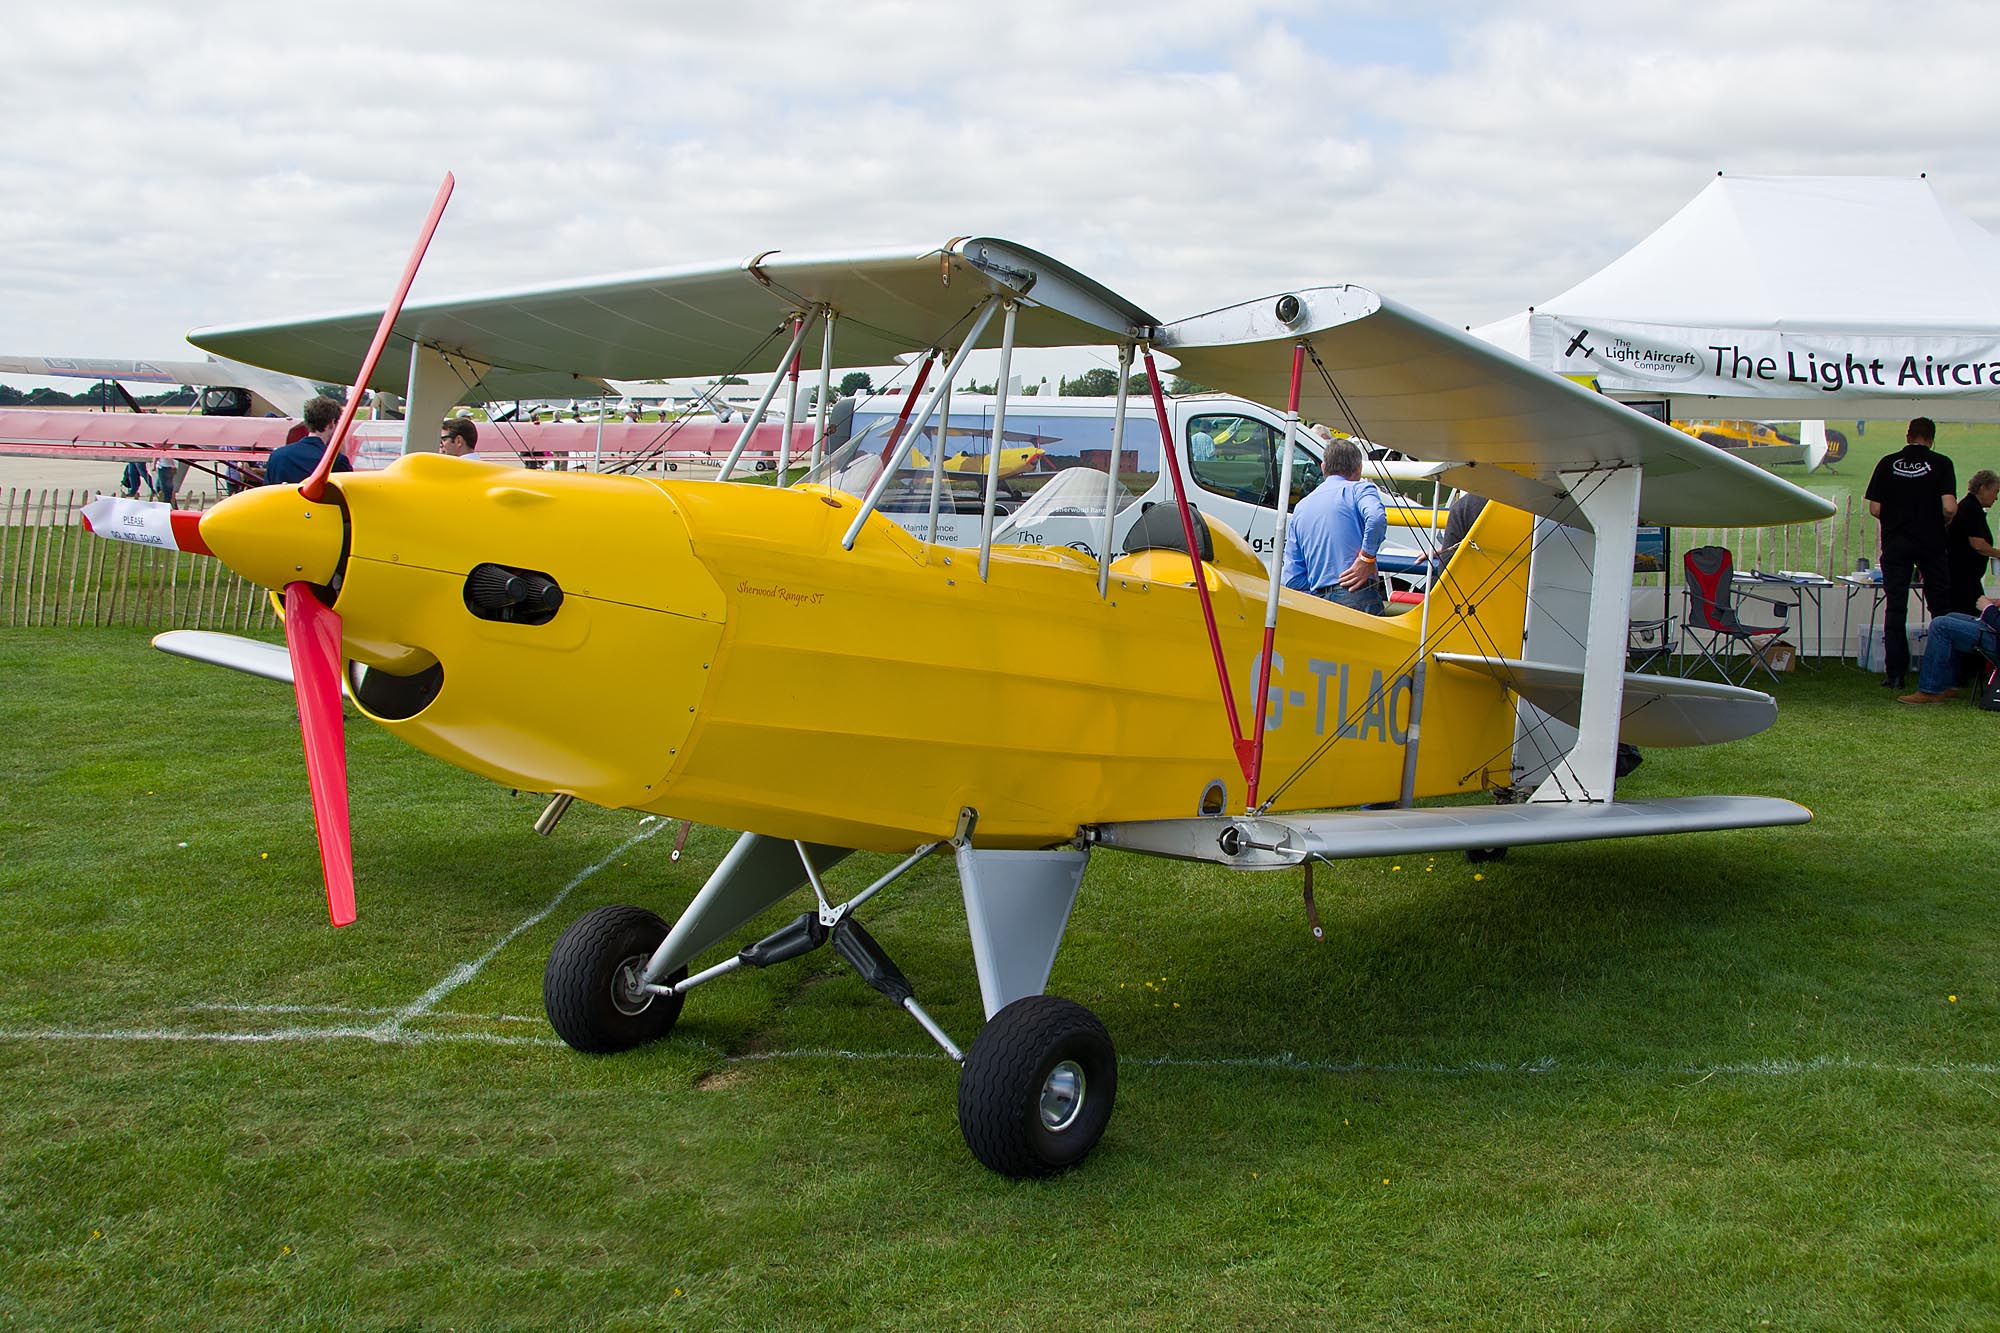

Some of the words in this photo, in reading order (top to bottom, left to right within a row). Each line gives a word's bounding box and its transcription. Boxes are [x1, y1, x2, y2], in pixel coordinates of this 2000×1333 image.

[1615, 338, 1632, 348] The
[1605, 346, 1640, 362] Light
[1643, 350, 1696, 365] Aircraft
[1634, 360, 1677, 373] Company
[1708, 345, 1777, 380] The
[1787, 350, 1886, 392] Light
[1897, 354, 2000, 386] Aircra
[123, 515, 145, 526] PLEASE
[903, 524, 954, 532] Maintence
[110, 530, 122, 539] DO
[123, 532, 137, 541] NOT
[139, 534, 162, 543] TOUCH
[1017, 530, 1044, 544] The
[736, 580, 778, 598] Sherwood
[778, 588, 809, 607] Ranger
[810, 593, 825, 605] ST
[1250, 649, 1413, 746] G-TLAC
